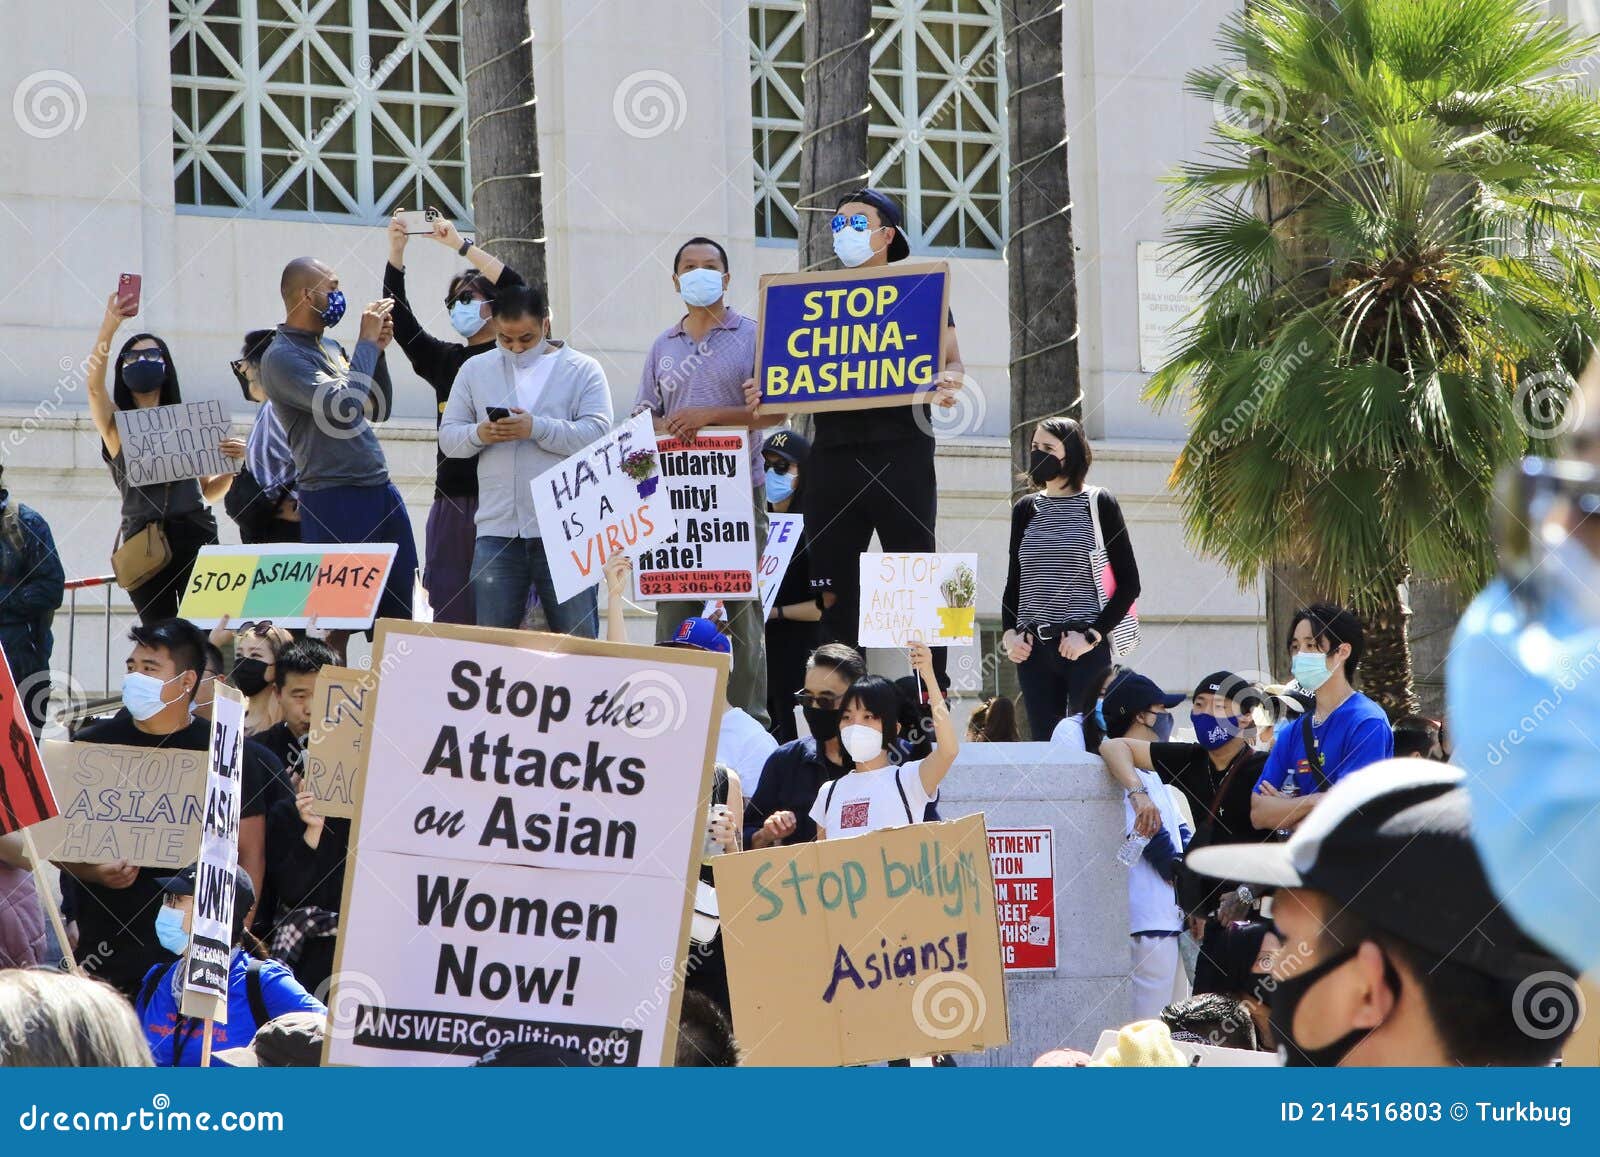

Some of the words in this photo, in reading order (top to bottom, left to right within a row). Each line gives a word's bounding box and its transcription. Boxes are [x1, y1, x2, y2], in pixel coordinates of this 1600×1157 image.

[803, 285, 898, 321] STOP
[787, 321, 917, 358] CHINA-
[766, 355, 933, 396] BASHING
[124, 413, 132, 434] I
[186, 400, 232, 426] FEEL
[128, 432, 171, 458] SAFE
[551, 431, 634, 510] HATE
[562, 512, 584, 541] IS
[599, 495, 614, 520] A
[666, 485, 717, 512] nity!
[571, 505, 655, 576] VIRUS
[687, 518, 750, 543] Asian
[192, 572, 247, 593] STOP
[252, 561, 319, 589] ASIAN
[316, 563, 380, 589] HATE
[641, 573, 689, 582] Socialist
[693, 572, 720, 581] Unity
[724, 571, 752, 581] Party
[641, 583, 672, 595] 323
[680, 581, 752, 593] 306-6240
[880, 556, 941, 584] STOP
[446, 660, 571, 733] Stop
[585, 682, 645, 729] the
[73, 746, 199, 795] STOP
[422, 725, 646, 796] Attacks
[65, 788, 203, 824] ASIAN
[63, 823, 185, 863] HATE
[413, 805, 466, 839] on
[478, 796, 637, 859] Asian
[416, 874, 618, 944] Women
[751, 860, 867, 922] Stop
[1013, 883, 1038, 901] THE
[434, 943, 582, 1007] Now!
[822, 932, 968, 1004] Asians!
[358, 1011, 630, 1065] ANSWERCoalition.org
